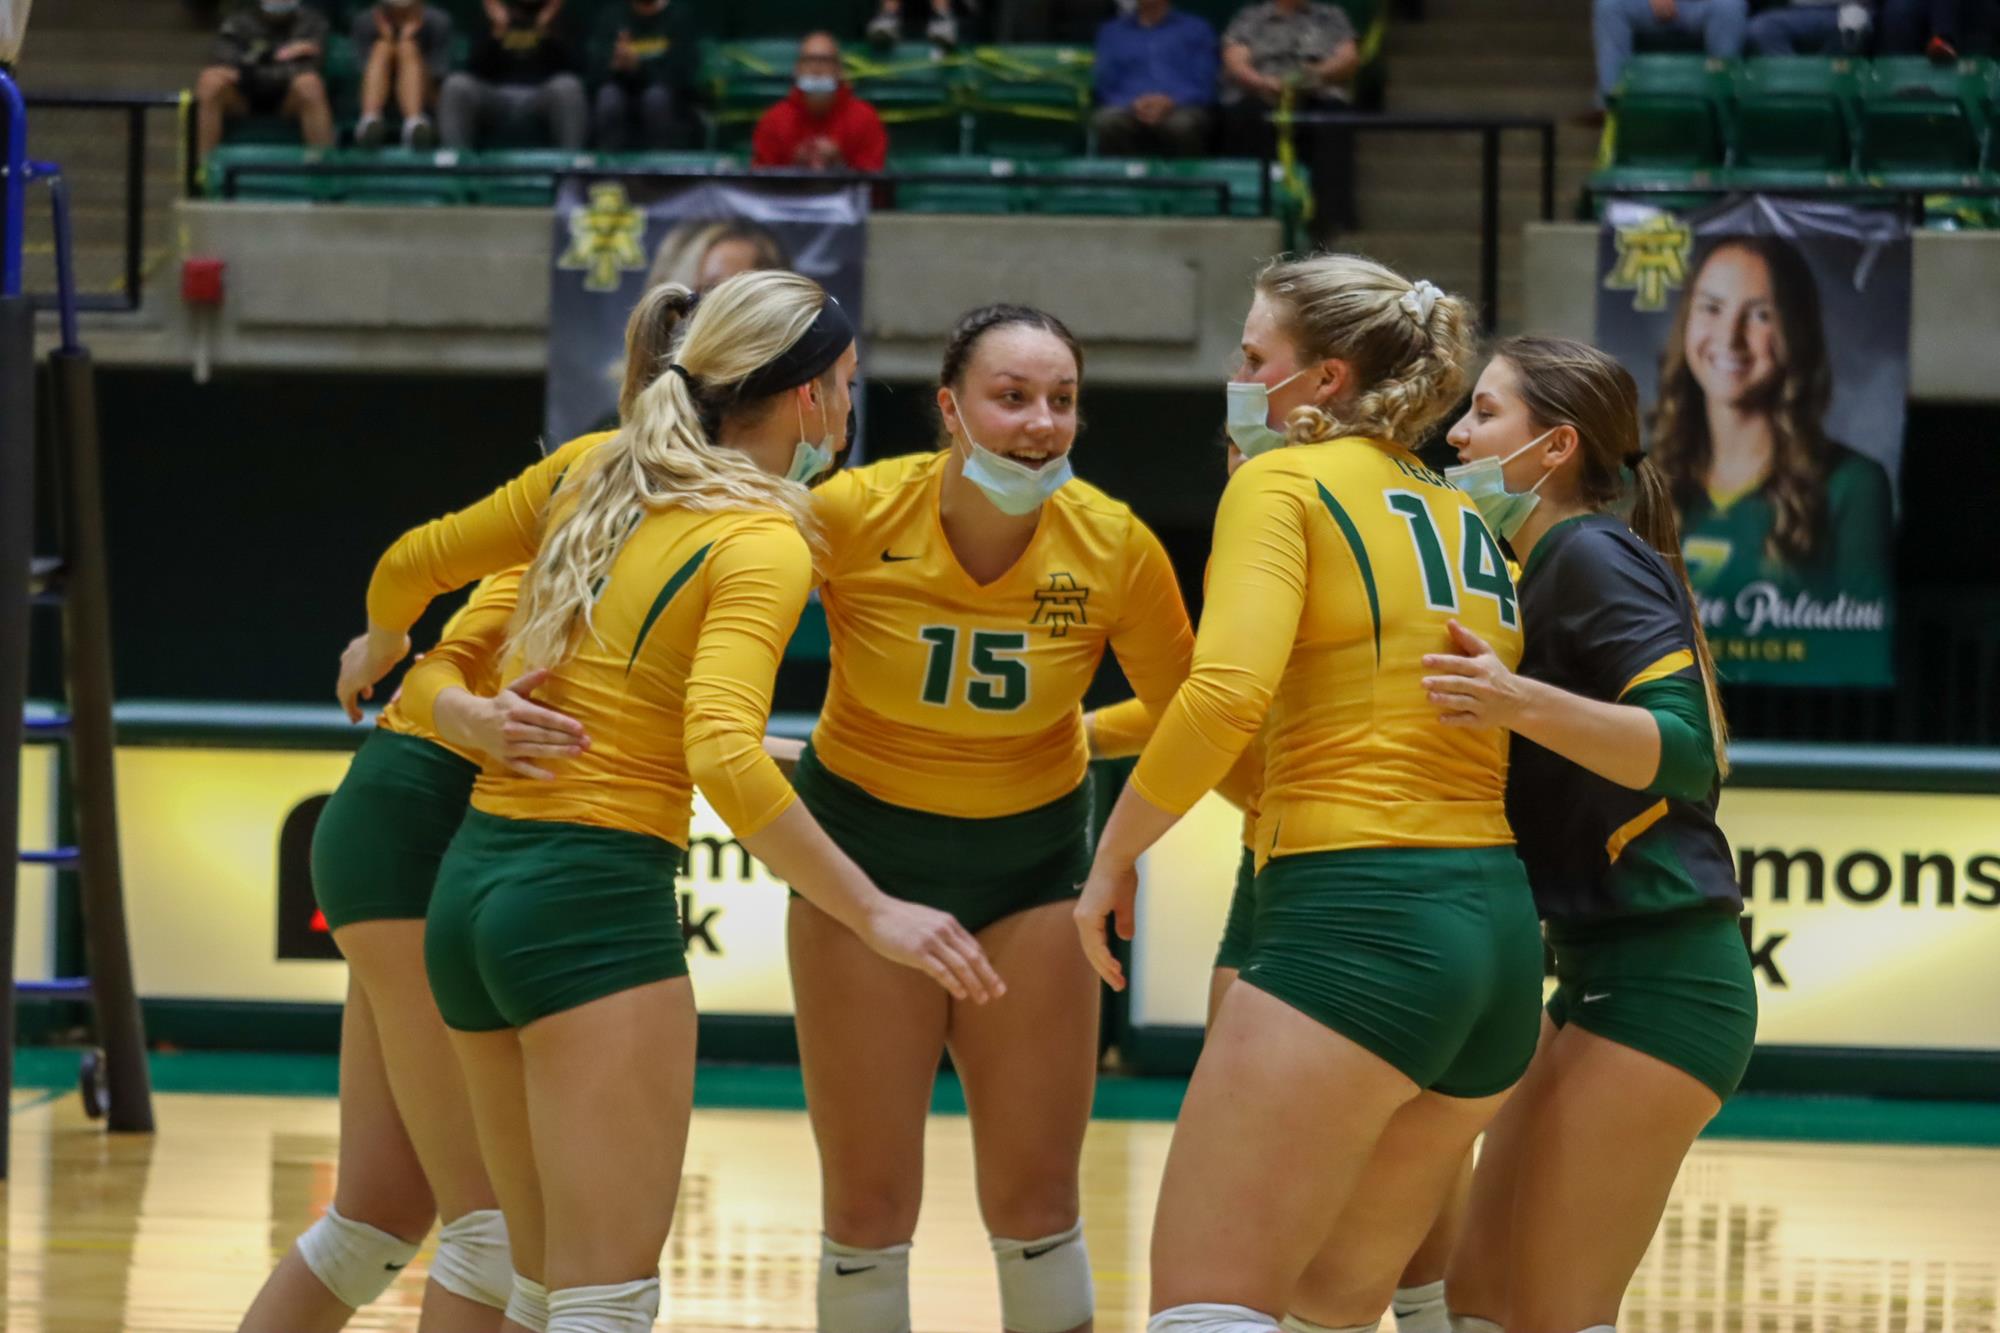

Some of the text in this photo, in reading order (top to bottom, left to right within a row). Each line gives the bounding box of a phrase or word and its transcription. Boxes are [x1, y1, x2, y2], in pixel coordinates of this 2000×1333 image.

[1383, 488, 1519, 632] 14
[919, 624, 1030, 714] 15
[1707, 639, 1807, 662] ENIOR
[1739, 847, 2000, 907] mons
